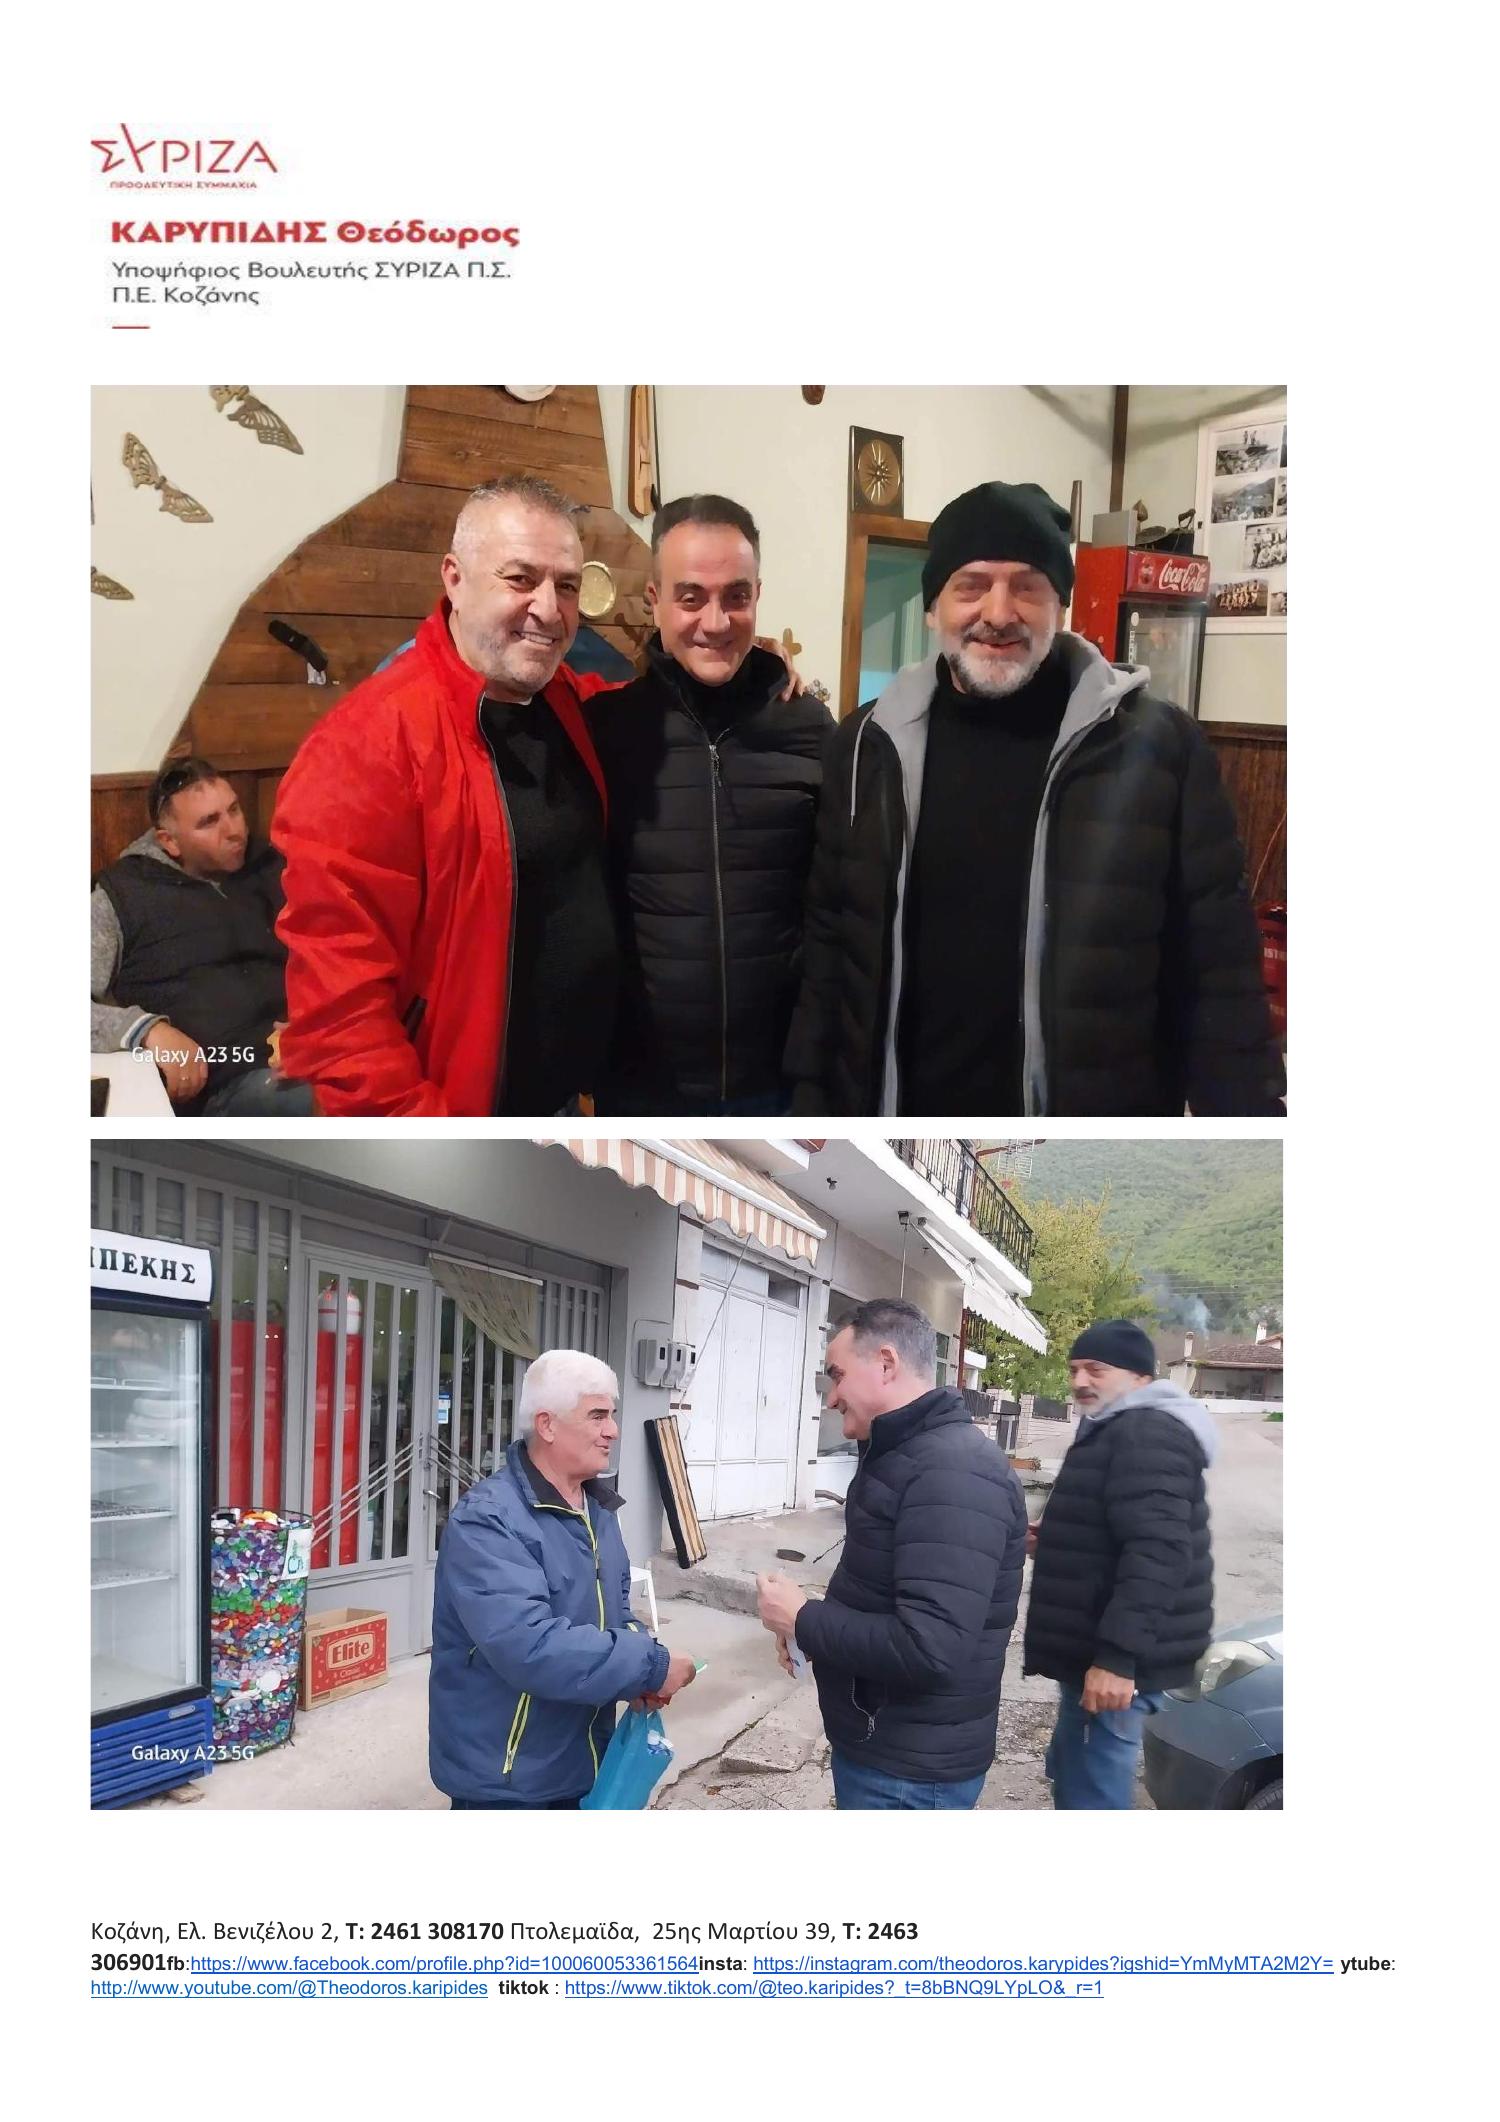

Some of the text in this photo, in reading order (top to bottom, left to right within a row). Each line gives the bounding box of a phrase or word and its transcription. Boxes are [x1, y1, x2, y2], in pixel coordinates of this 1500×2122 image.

[91, 123, 278, 173] ΣΥΡΙΖΑ
[110, 181, 257, 189] ΠΡΟΟΔΕΥΤΙΚΗ ΣΥΜΜΑΧΙΑ
[112, 219, 519, 249] ΚΑΡΥΠΙΔΗΣ Θεόδωρος
[112, 261, 511, 282] Υποψήφιος Βουλευτής ΣΥΡΙΖΑ Π.Σ.
[113, 286, 260, 306] Π.Ε. Κοζάνης
[1159, 559, 1207, 592] Coca-Cola
[332, 1639, 370, 1665] Elite
[92, 1921, 170, 1944] Κοζάνη,
[178, 1922, 206, 1940] Ελ.
[214, 1921, 314, 1944] Βενιζέλου
[321, 1923, 339, 1944] 2,
[371, 1923, 422, 1940] 2461
[428, 1923, 504, 1940] 308170
[511, 1922, 640, 1944] Πτολεμαϊδα,
[652, 1923, 701, 1944] 25ης
[708, 1921, 798, 1944] Μαρτίου
[805, 1923, 836, 1944] 39,
[868, 1923, 919, 1940] 2463
[1340, 1956, 1395, 1974] ytube:
[91, 1980, 488, 1998] http://www.youtube.com/@Theodoros.karipides
[498, 1980, 549, 1995] tiktok
